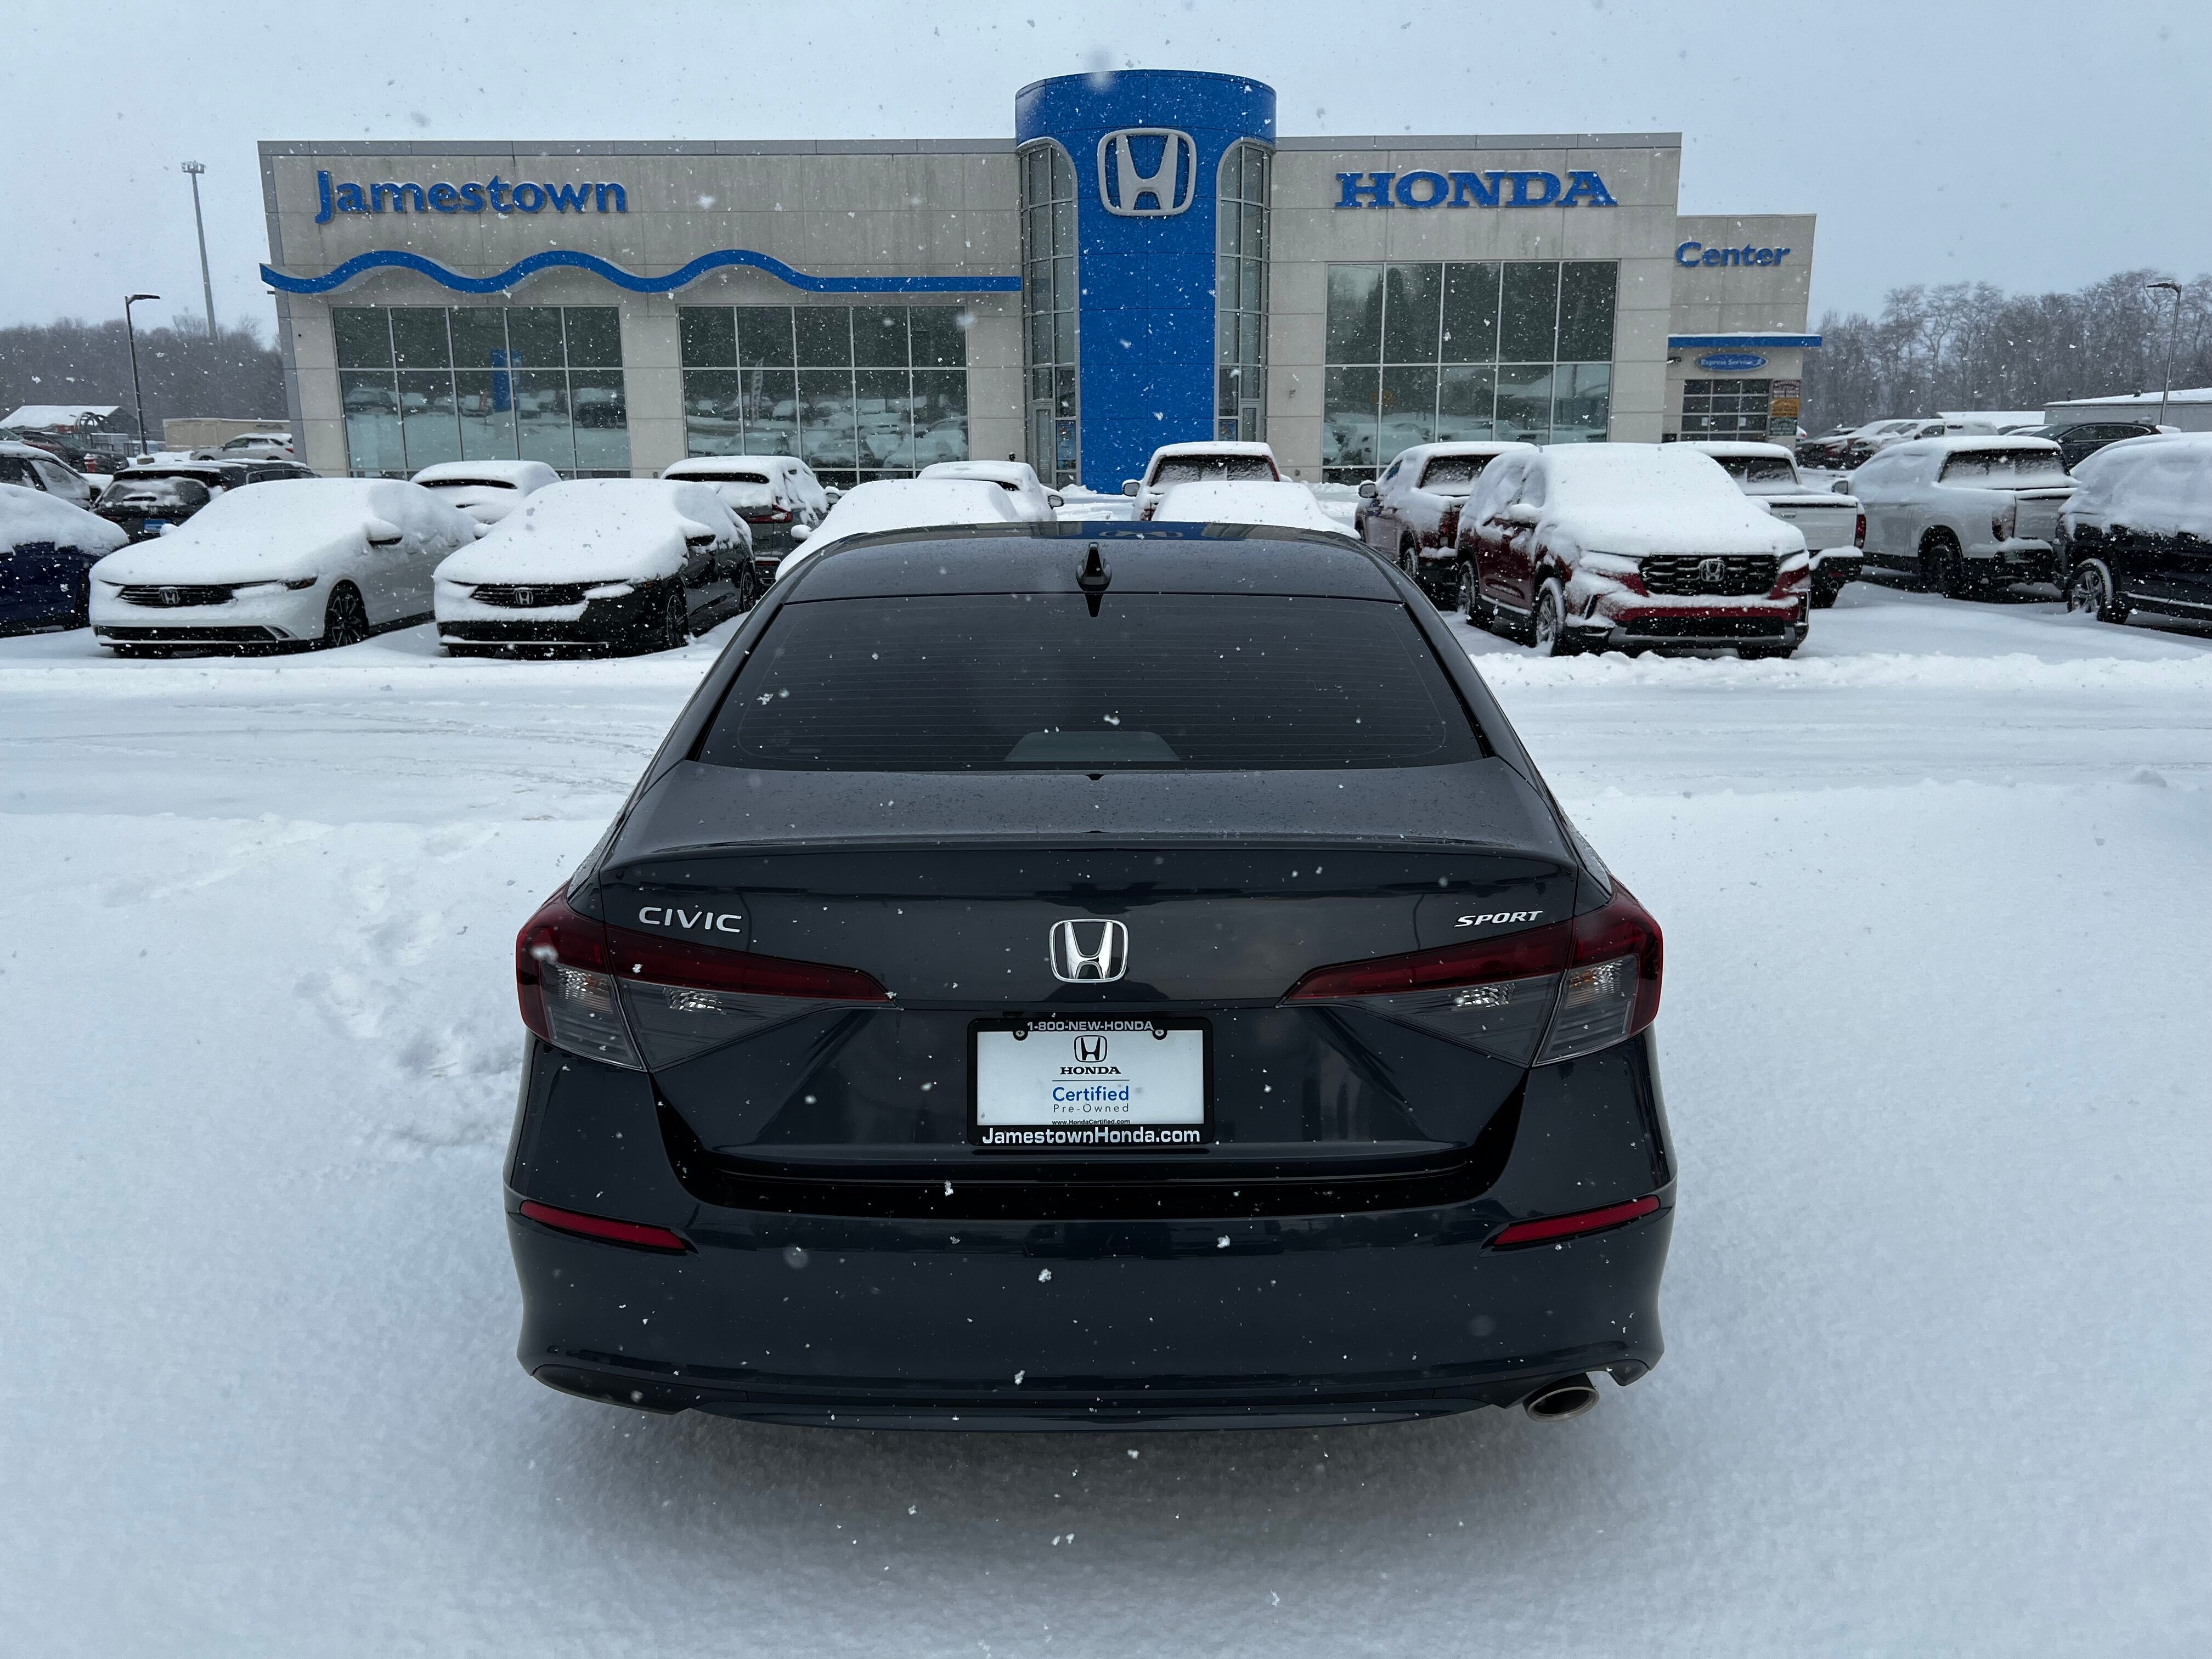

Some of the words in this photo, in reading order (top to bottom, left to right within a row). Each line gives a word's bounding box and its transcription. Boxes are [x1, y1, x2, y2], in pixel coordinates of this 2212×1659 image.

[315, 171, 626, 223] Jamestown
[1336, 171, 1617, 208] HONDA
[1676, 241, 1790, 267] Center
[639, 907, 741, 933] CIVIC
[1454, 911, 1543, 927] SPORT
[1028, 1021, 1153, 1031] 1-800-NEW-HONDA
[1060, 1066, 1121, 1075] HONDA
[1052, 1086, 1129, 1102] Certified
[1053, 1103, 1129, 1113] Pre-Owned
[982, 1127, 1200, 1144] JamestownHonda.com
